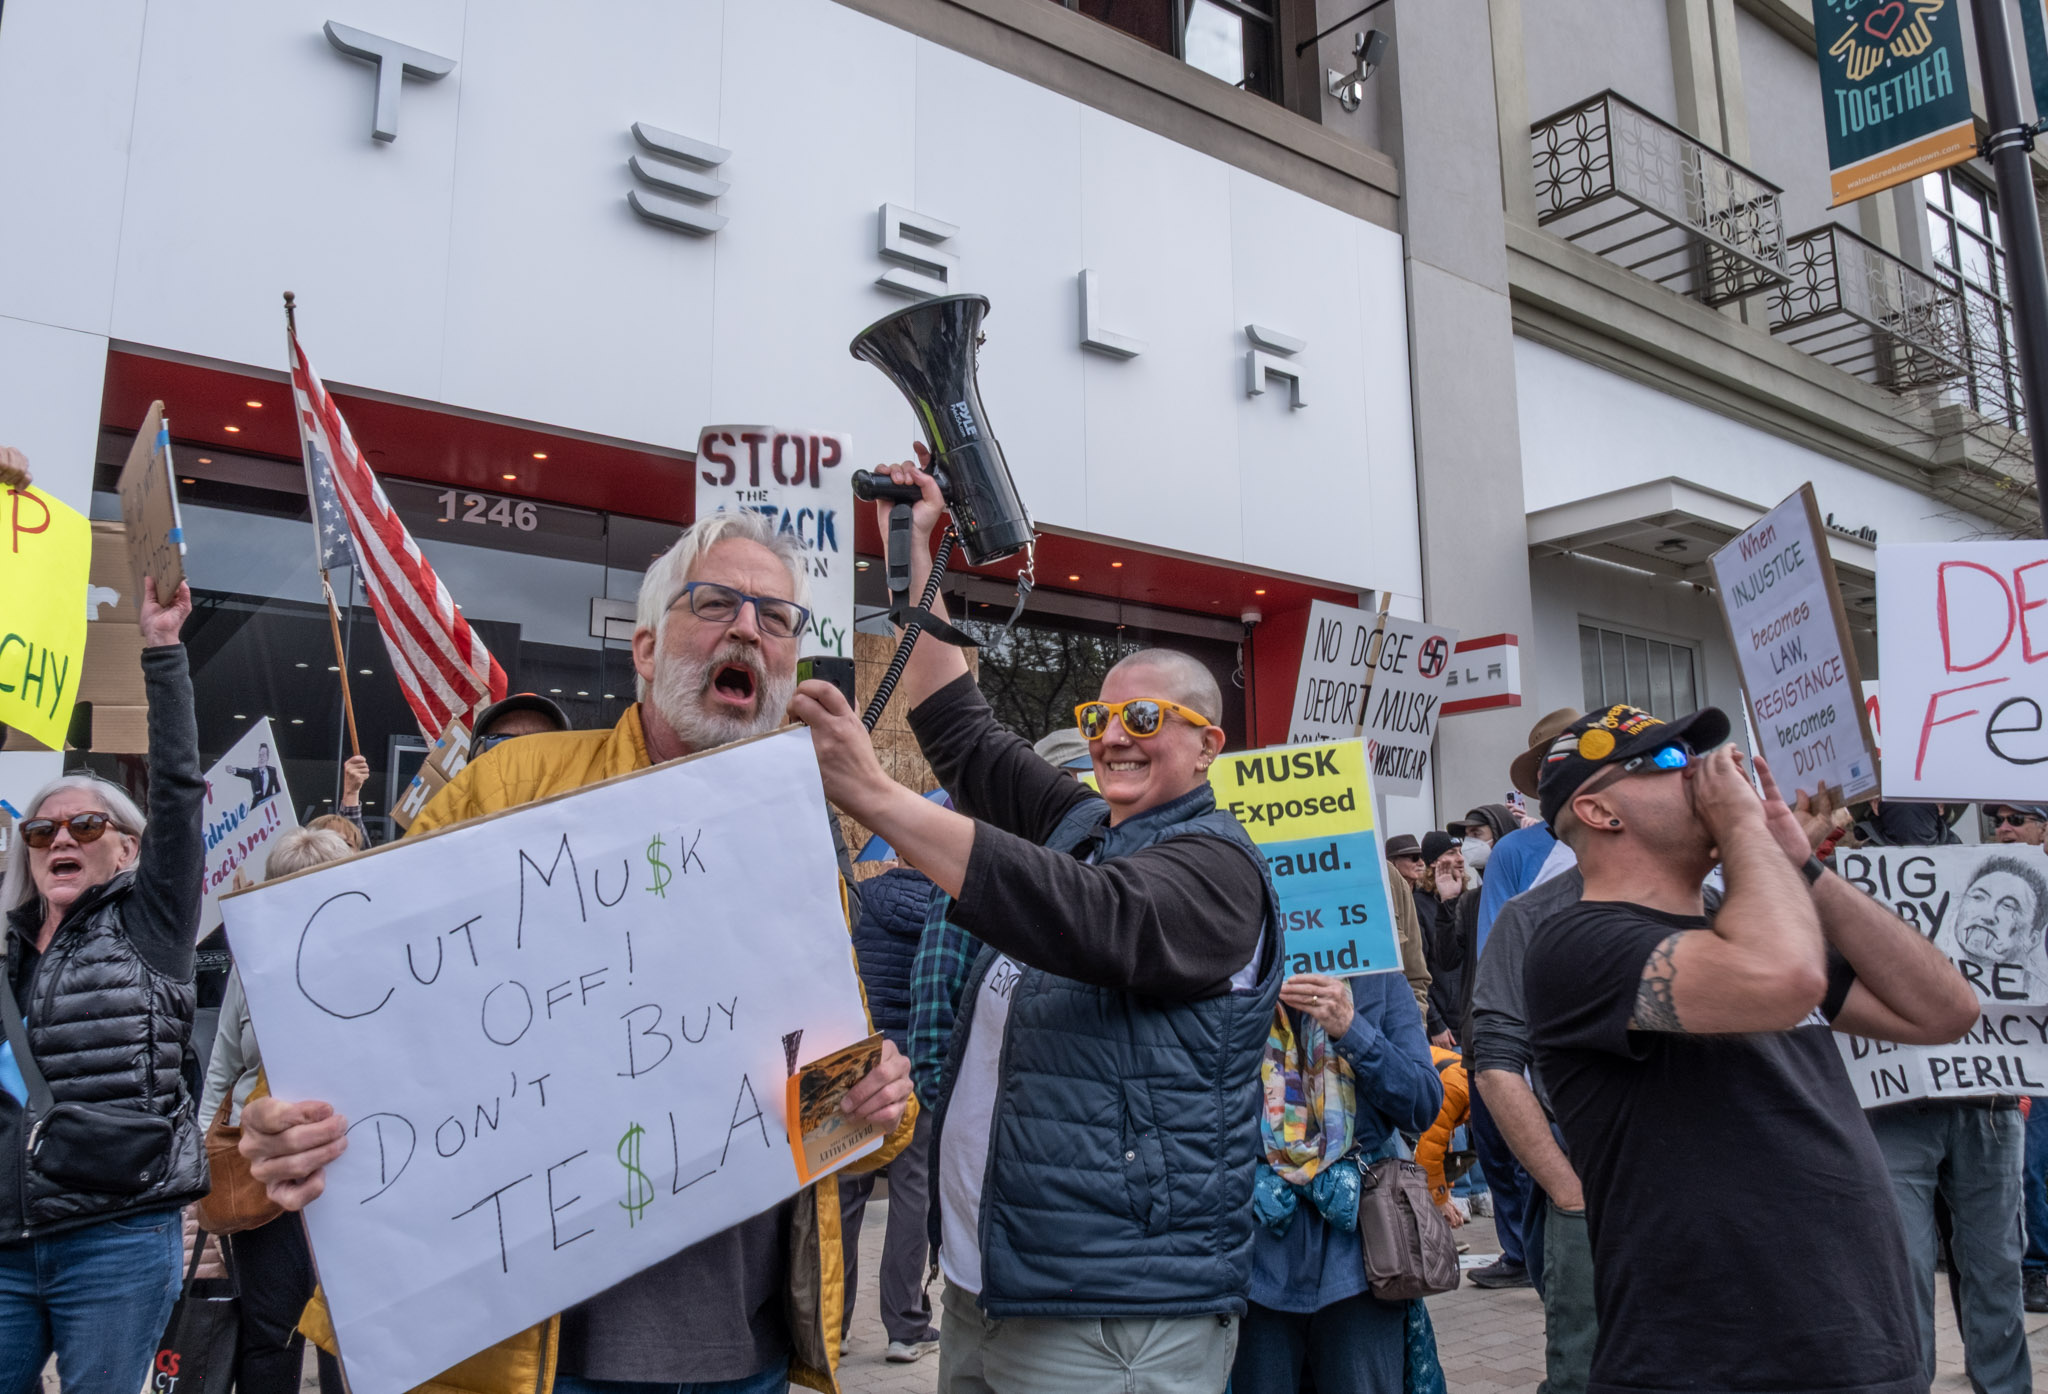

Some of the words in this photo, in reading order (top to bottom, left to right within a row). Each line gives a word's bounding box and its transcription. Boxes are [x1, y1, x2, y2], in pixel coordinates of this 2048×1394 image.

[1834, 46, 1954, 137] TOGETHER
[1847, 143, 1961, 189] walnutcreekdowntown.com
[322, 19, 1307, 413] TESLA
[955, 400, 977, 436] PYLE
[701, 432, 842, 488] STOP
[438, 490, 538, 532] 1246
[736, 490, 768, 501] THE
[716, 504, 839, 553] TACK
[1738, 523, 1777, 563] When
[1731, 540, 1805, 609] INJUSTICE
[1314, 617, 1343, 663] NO
[1350, 624, 1413, 674] DOGE
[1750, 600, 1810, 651] becomes
[1446, 663, 1502, 687] SLA
[1769, 635, 1808, 675] LAW,
[1303, 677, 1371, 726] DEPORT
[1372, 687, 1438, 736] MUSK
[1754, 655, 1845, 724] RESISTANCE
[1775, 704, 1836, 748] becomes
[1235, 748, 1340, 786] MUSK
[1792, 735, 1837, 776] DUTY!
[1229, 787, 1356, 826] Exposed
[1844, 854, 1936, 900] BIG
[297, 890, 483, 1020] CUT
[517, 828, 707, 950] MU$K
[1338, 904, 1368, 926] IS
[1895, 890, 1950, 944] BY
[481, 931, 634, 1046] OFF!
[1950, 957, 2030, 1000] RE
[1871, 1064, 1910, 1099] IN
[1928, 1055, 2045, 1092] PERIL
[344, 1072, 553, 1206] DON'T
[617, 996, 738, 1079] BUY
